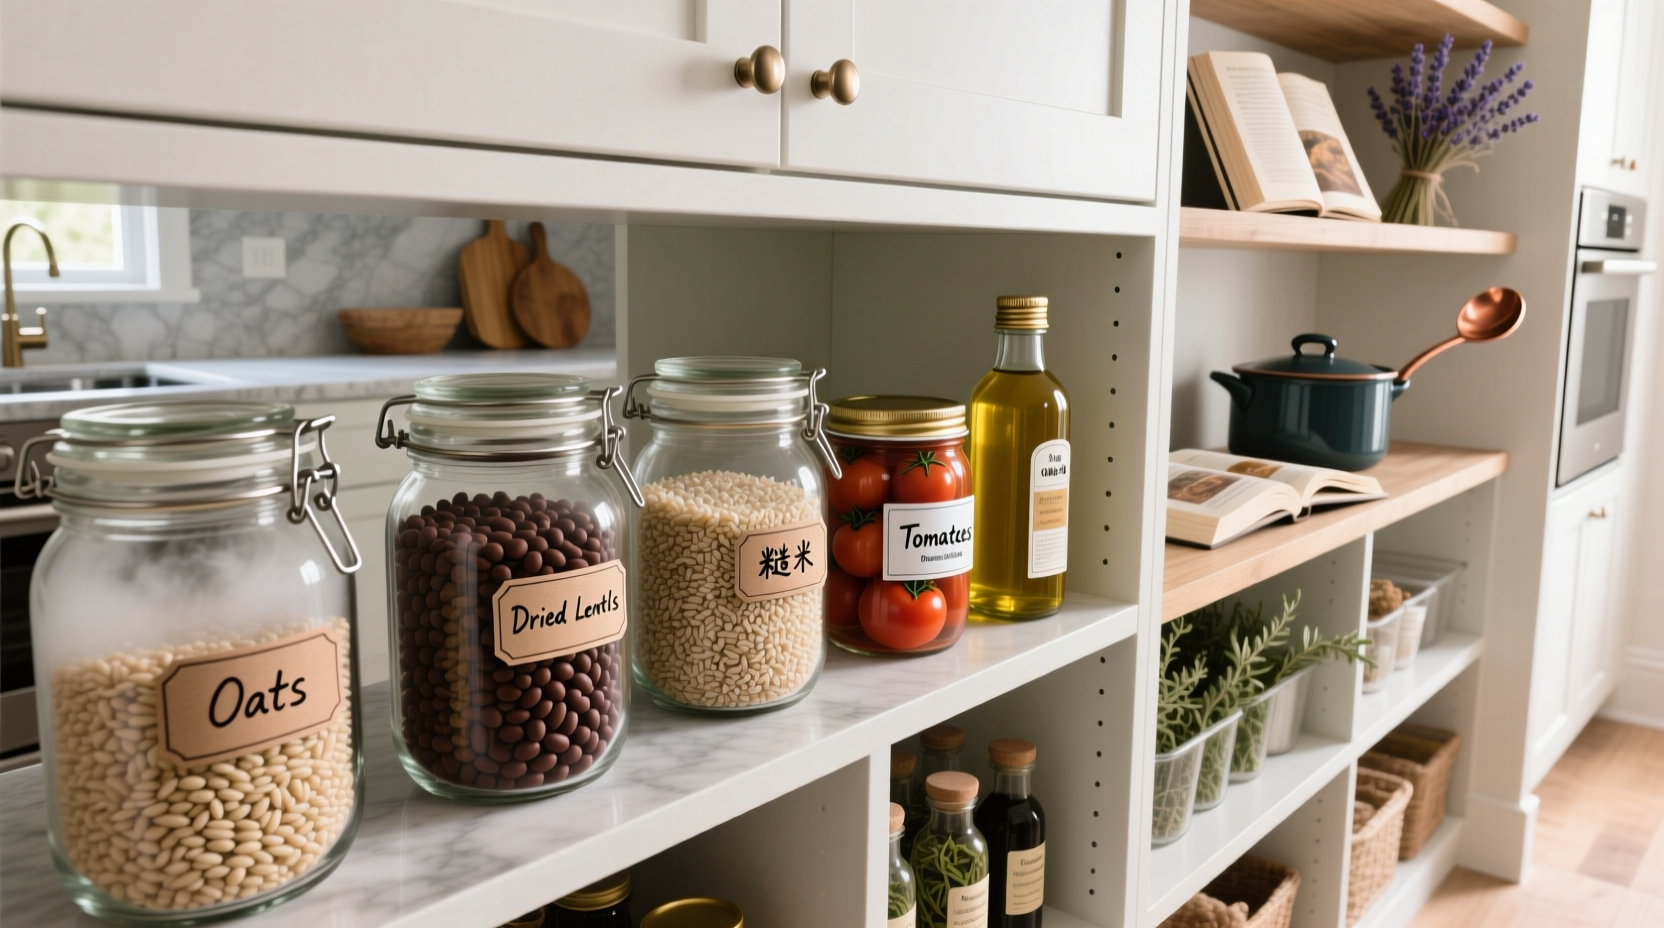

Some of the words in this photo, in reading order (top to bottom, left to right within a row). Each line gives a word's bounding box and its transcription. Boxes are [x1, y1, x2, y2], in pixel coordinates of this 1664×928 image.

[758, 539, 814, 580] 糙米
[511, 600, 567, 635] Dried
[208, 669, 307, 729] Oats
